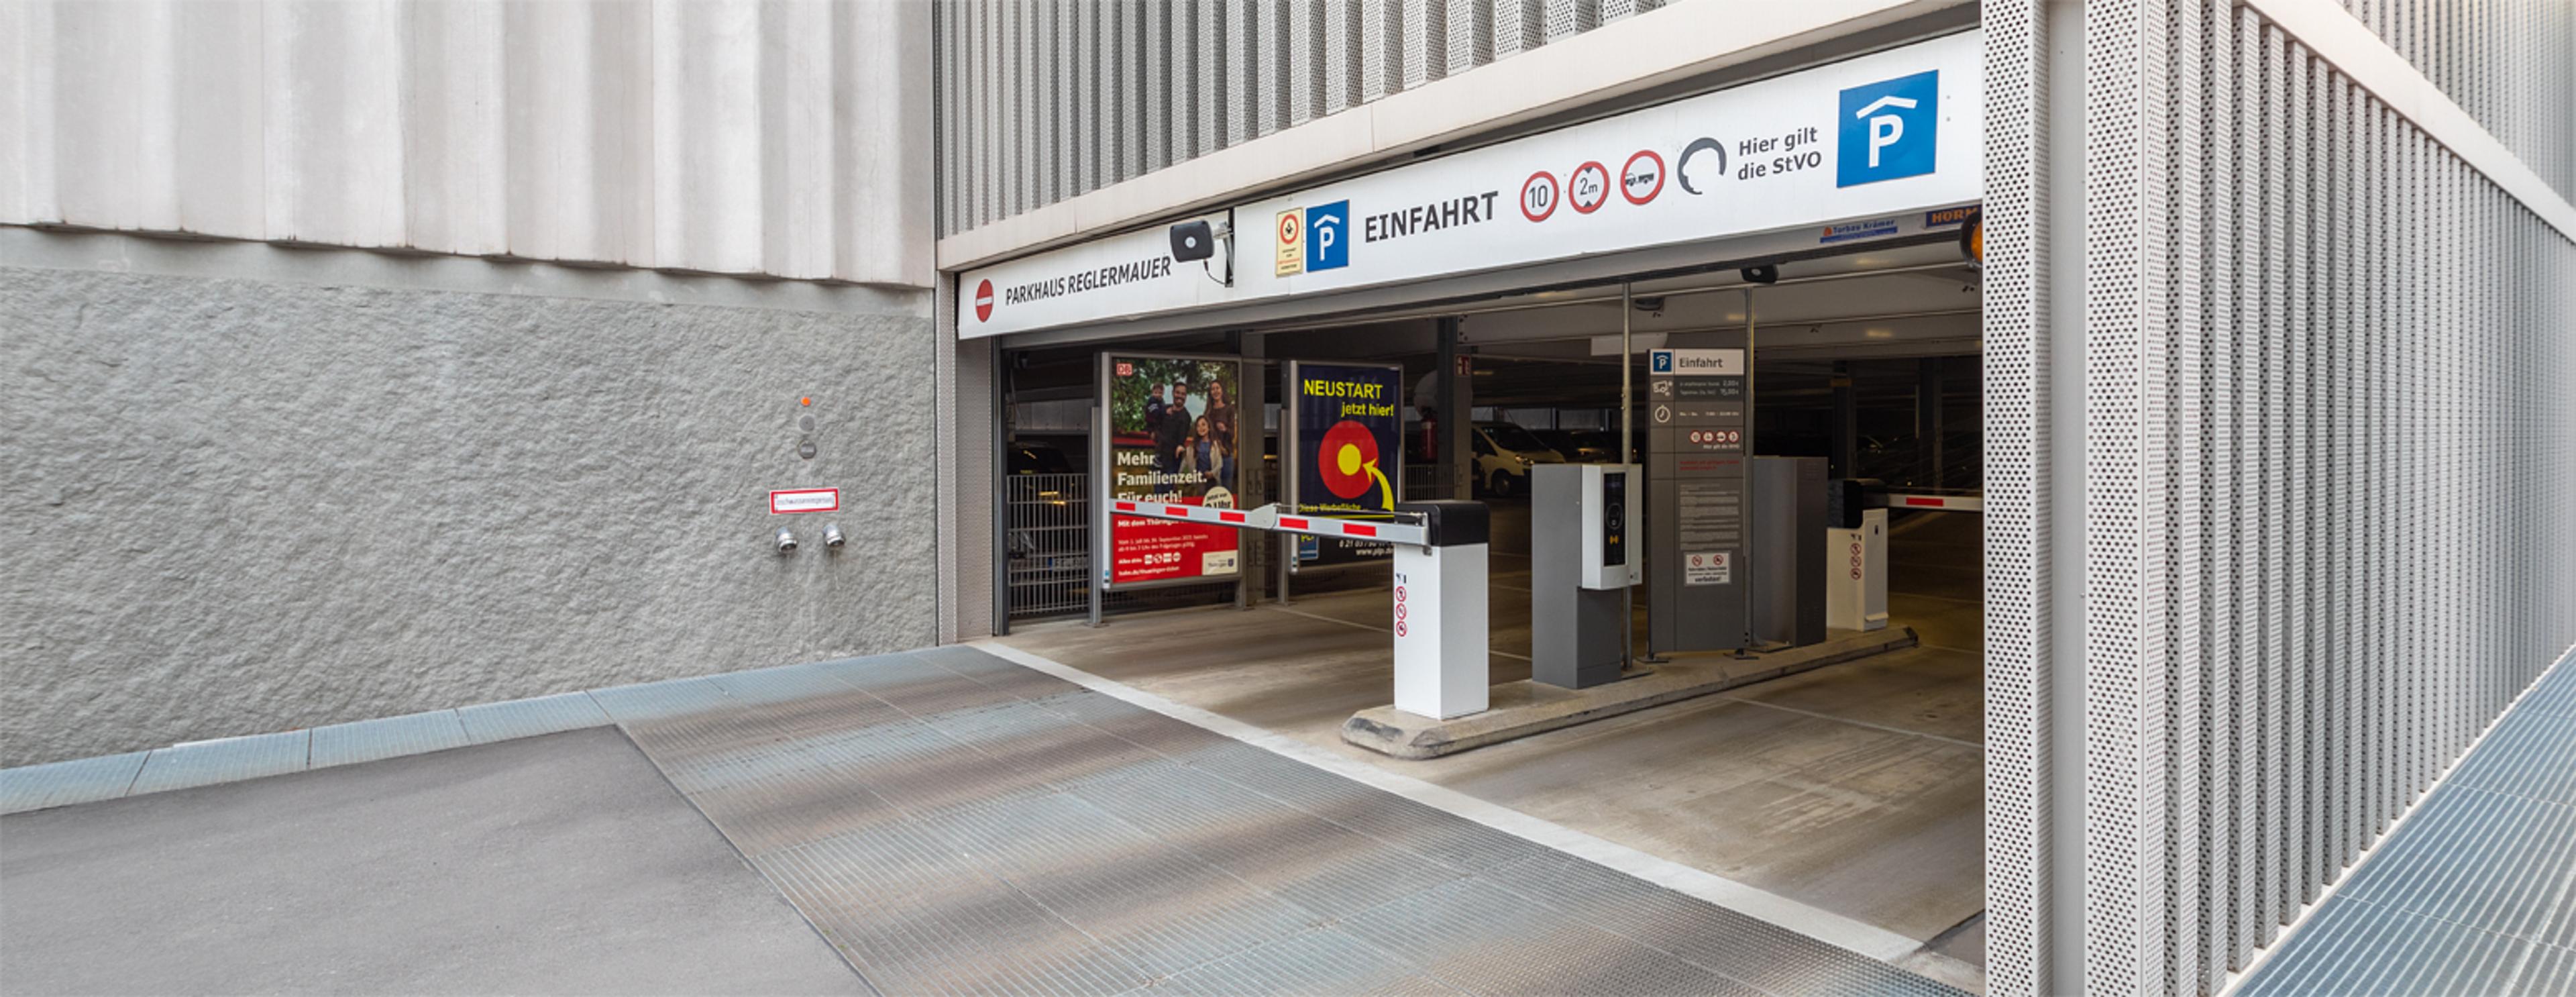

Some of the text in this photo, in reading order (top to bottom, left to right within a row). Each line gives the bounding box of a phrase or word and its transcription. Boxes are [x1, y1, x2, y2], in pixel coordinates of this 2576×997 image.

[1739, 126, 1818, 156] Hier gilt
[1868, 113, 1904, 168] P
[1737, 151, 1822, 180] die StVO
[1528, 185, 1548, 209] 10
[1365, 191, 1499, 243] EINFAHRT
[1320, 226, 1335, 261] P
[1005, 255, 1171, 306] PARKHAUS REGLERMAUER
[1679, 357, 1723, 368] Einfahrt
[1303, 378, 1383, 400] NEUSTART
[1341, 401, 1395, 417] jetzt hier!
[1117, 452, 1155, 466] Mehr
[1117, 470, 1208, 486] Familienzeit.
[1118, 490, 1183, 503] Für euch!
